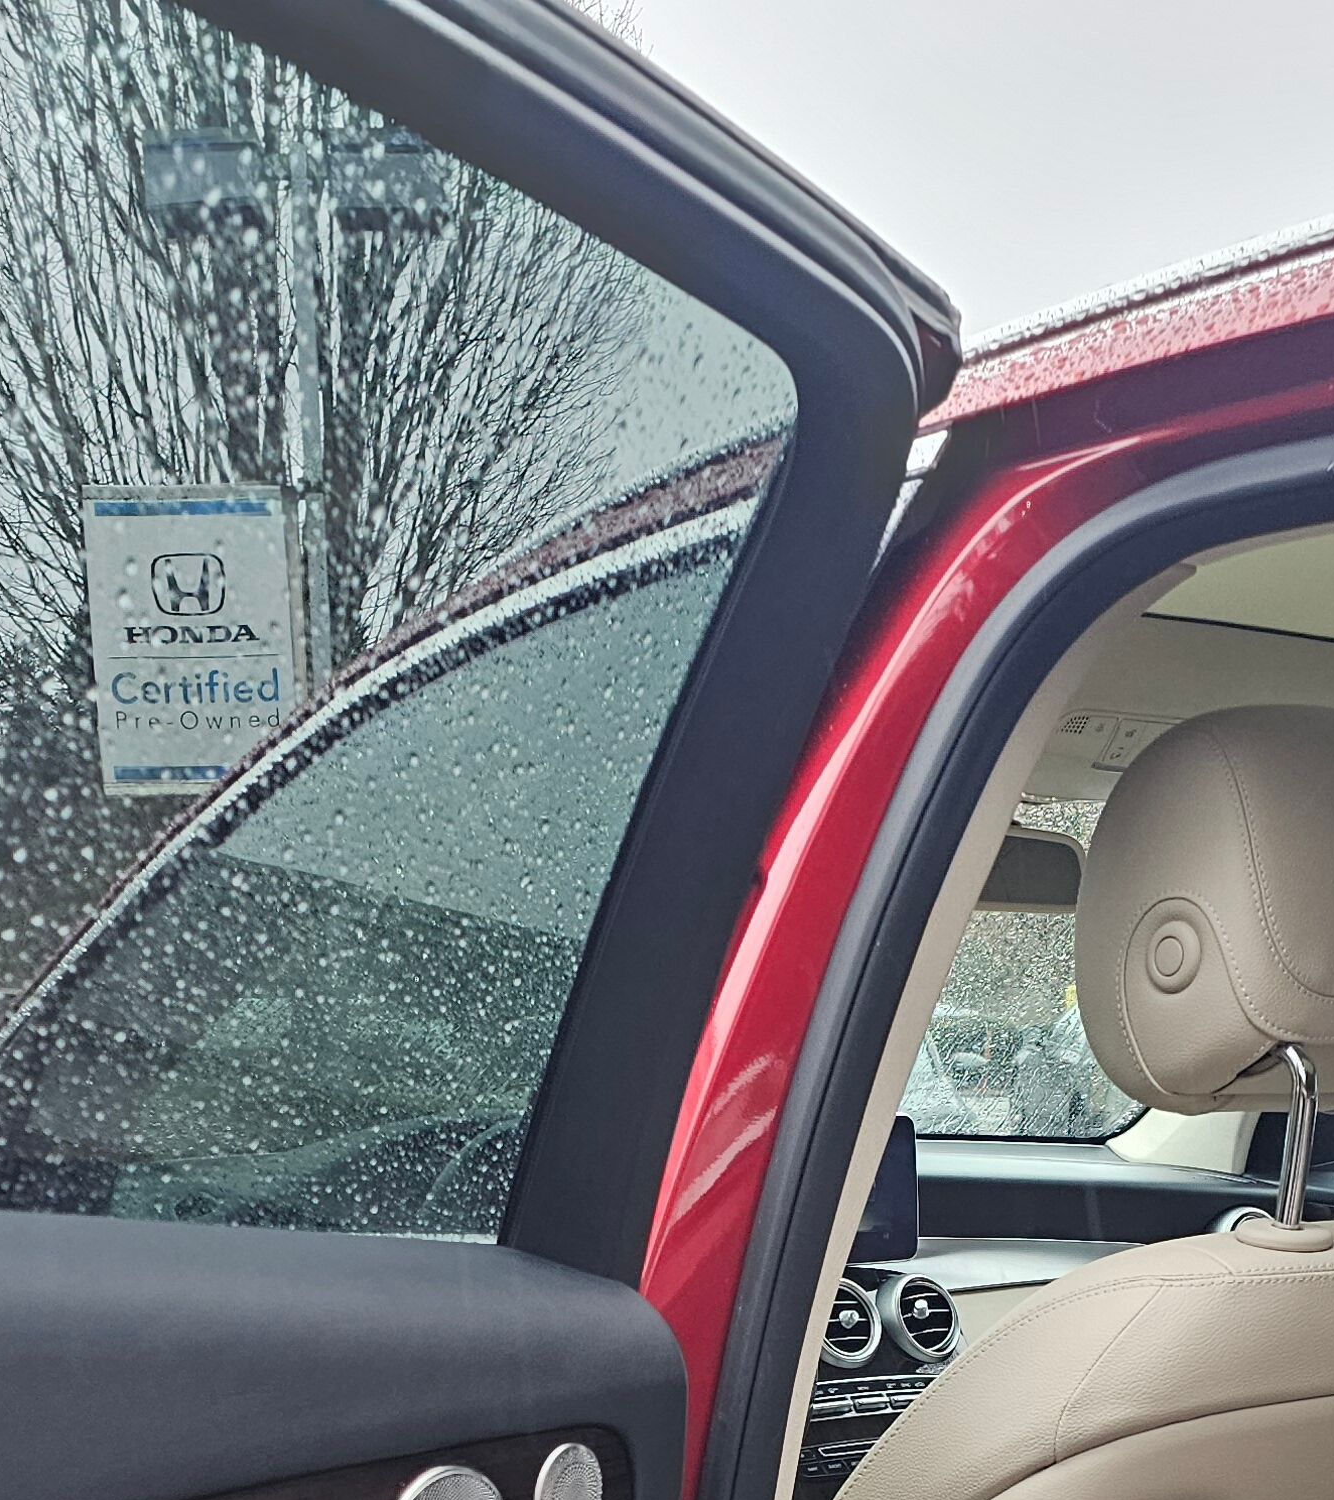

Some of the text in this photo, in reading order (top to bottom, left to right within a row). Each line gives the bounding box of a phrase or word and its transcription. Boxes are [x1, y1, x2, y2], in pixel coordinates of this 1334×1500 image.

[123, 624, 260, 645] HONDA
[110, 666, 281, 705] Certified
[115, 707, 281, 731] Pre-Owned
